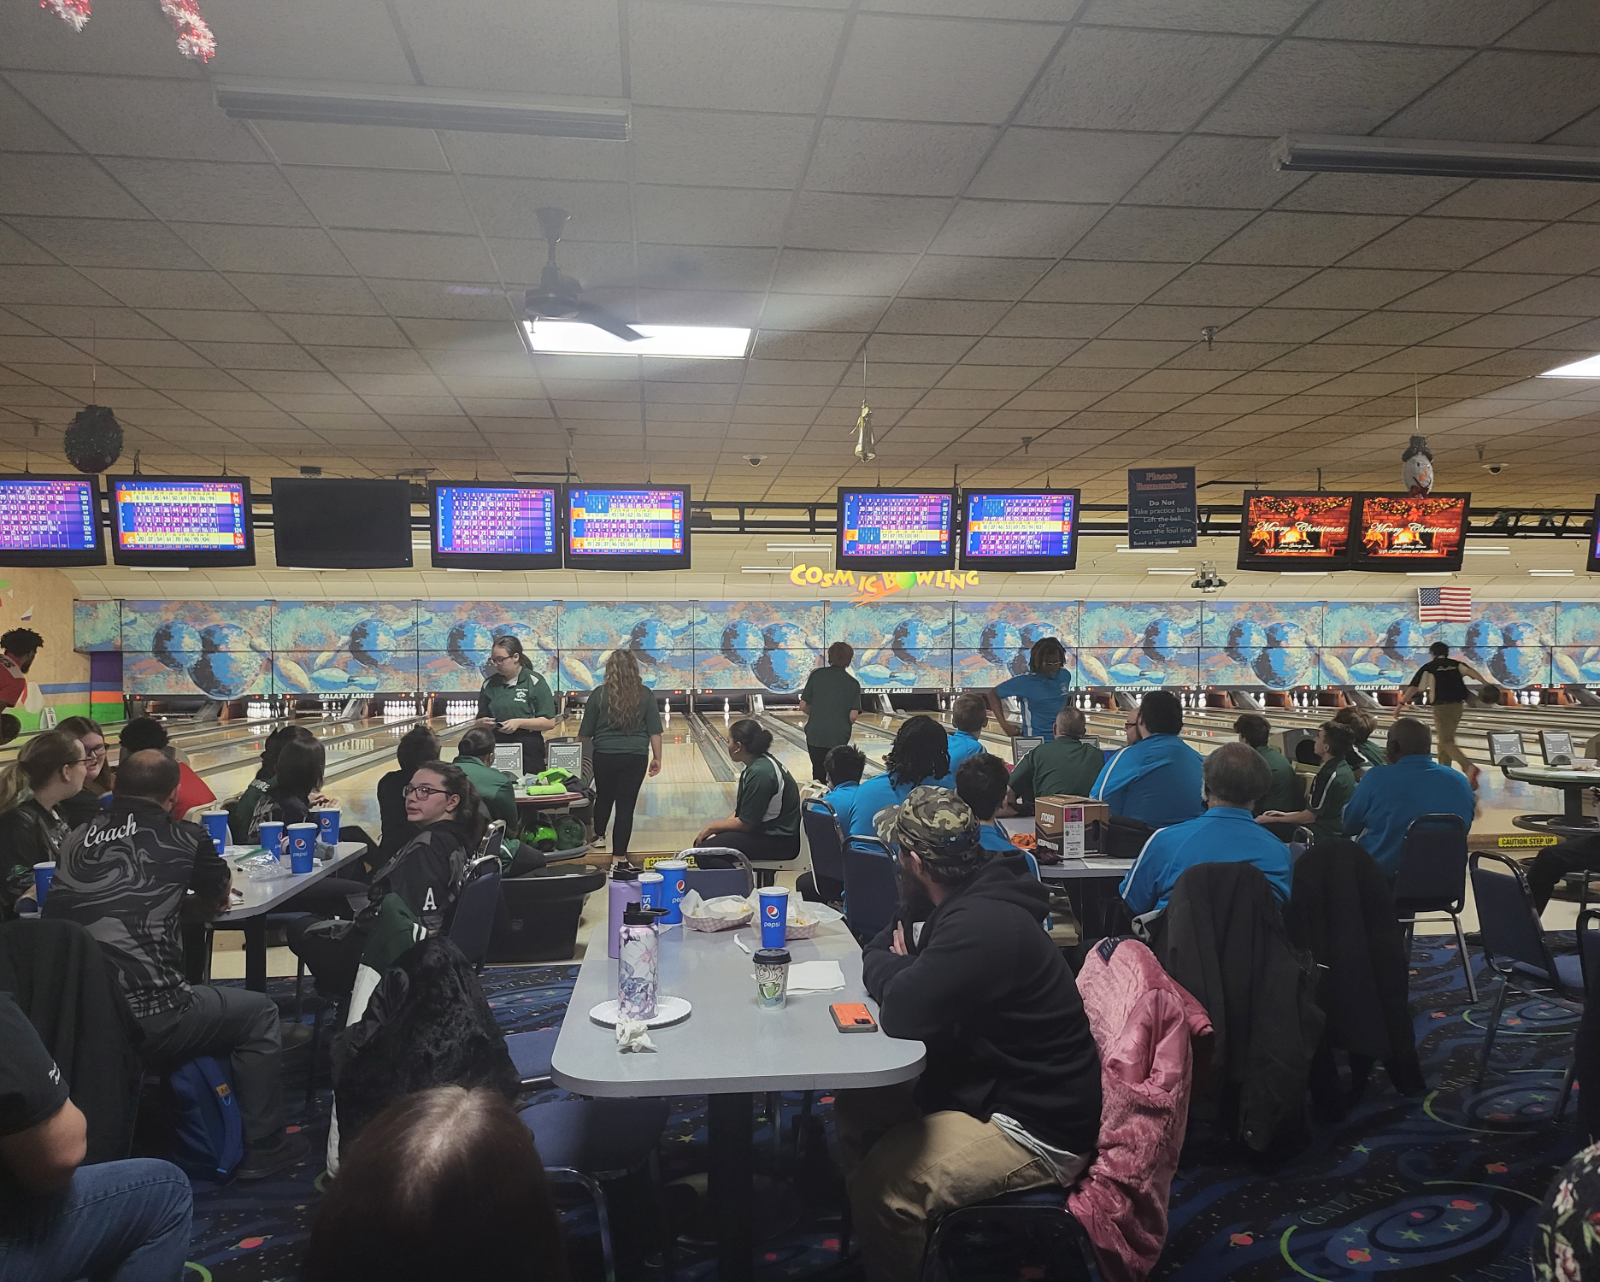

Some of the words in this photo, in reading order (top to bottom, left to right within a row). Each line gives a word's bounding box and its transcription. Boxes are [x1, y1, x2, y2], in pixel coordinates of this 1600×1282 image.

[1136, 481, 1188, 490] Remember
[1255, 521, 1290, 535] Merry
[1295, 522, 1345, 532] Christmas
[1370, 523, 1403, 536] Merry
[1408, 522, 1457, 533] Christmas
[790, 564, 877, 593] COSMIC
[882, 570, 979, 590] BOWLING
[84, 813, 138, 847] Coach
[423, 887, 437, 910] A
[1300, 1181, 1409, 1226] GALAXY
